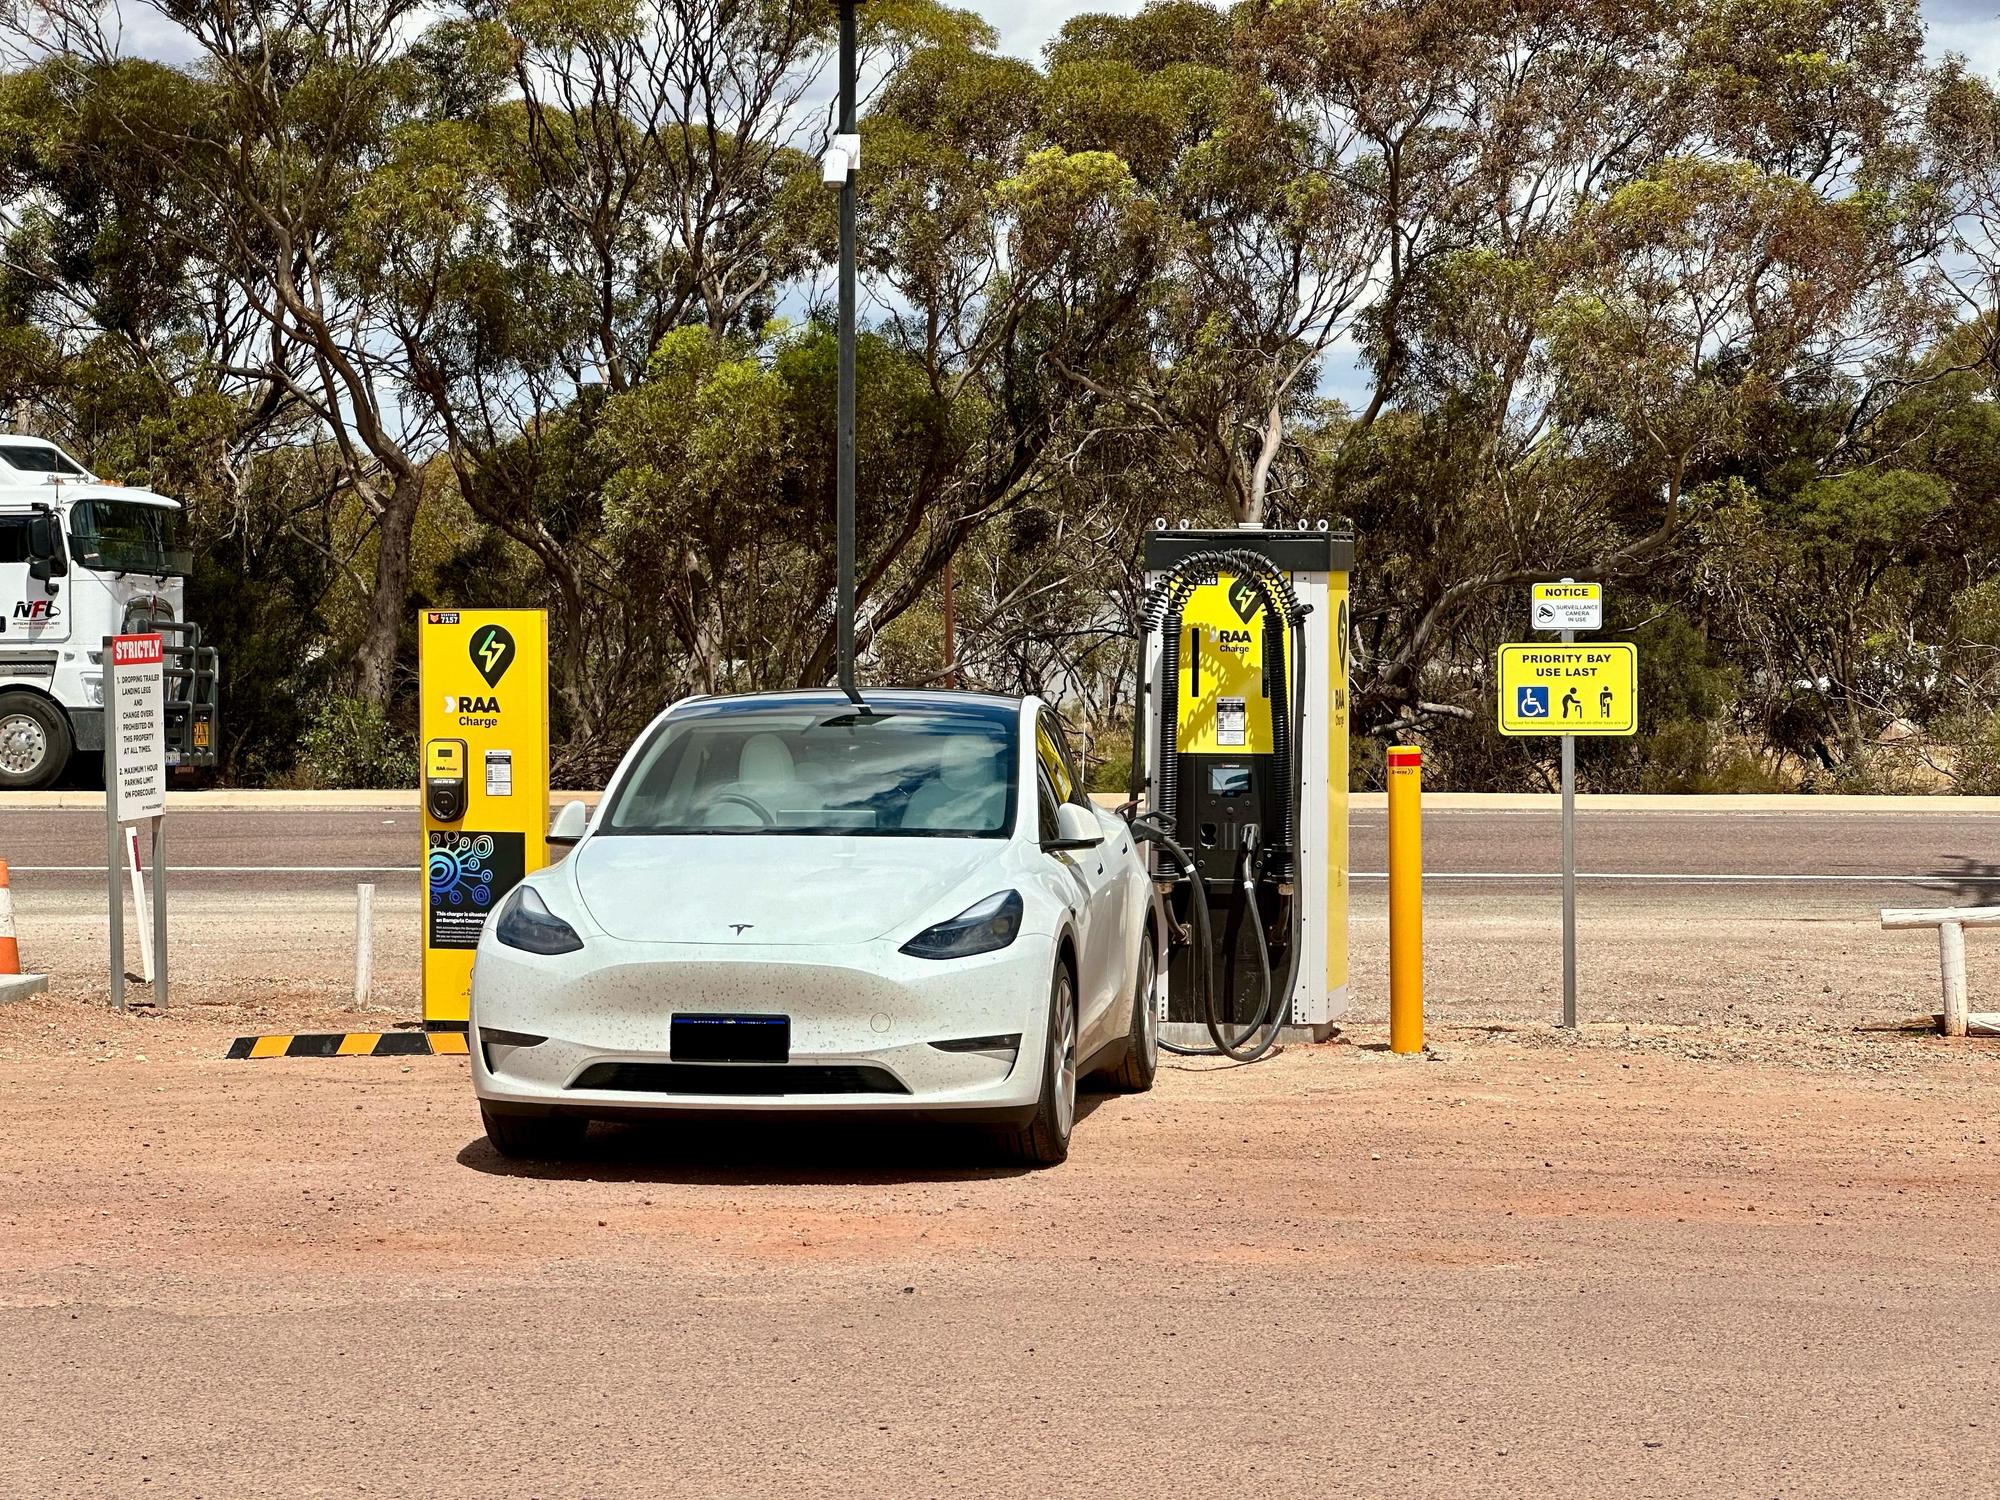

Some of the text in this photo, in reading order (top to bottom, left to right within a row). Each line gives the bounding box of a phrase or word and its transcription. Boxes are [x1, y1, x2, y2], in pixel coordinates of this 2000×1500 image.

[1545, 588, 1589, 597] NOTICE
[13, 600, 60, 618] NFL
[440, 616, 459, 624] 7157
[1219, 630, 1252, 643] RAA
[115, 639, 160, 660] STRICTLY
[1219, 644, 1250, 655] Charge
[1522, 654, 1612, 664] PRIORITY BAY
[1536, 667, 1598, 677] USE LAST
[121, 675, 143, 684] DROPPING
[143, 673, 160, 682] TRAILER
[122, 686, 152, 695] LANDING LEGS
[133, 698, 143, 706] AND
[458, 696, 501, 713] RAA
[122, 709, 154, 719] CHANGE OVERS
[122, 721, 154, 731] PROHIBITED ON
[458, 716, 498, 728] Charge
[133, 733, 154, 742] PROPERTY
[124, 747, 130, 755] AT
[130, 746, 138, 754] ALL
[123, 765, 144, 775] MAXIMUM
[147, 763, 158, 772] HOUR
[124, 776, 154, 786] PARKING LIMIT
[124, 791, 132, 799] ON
